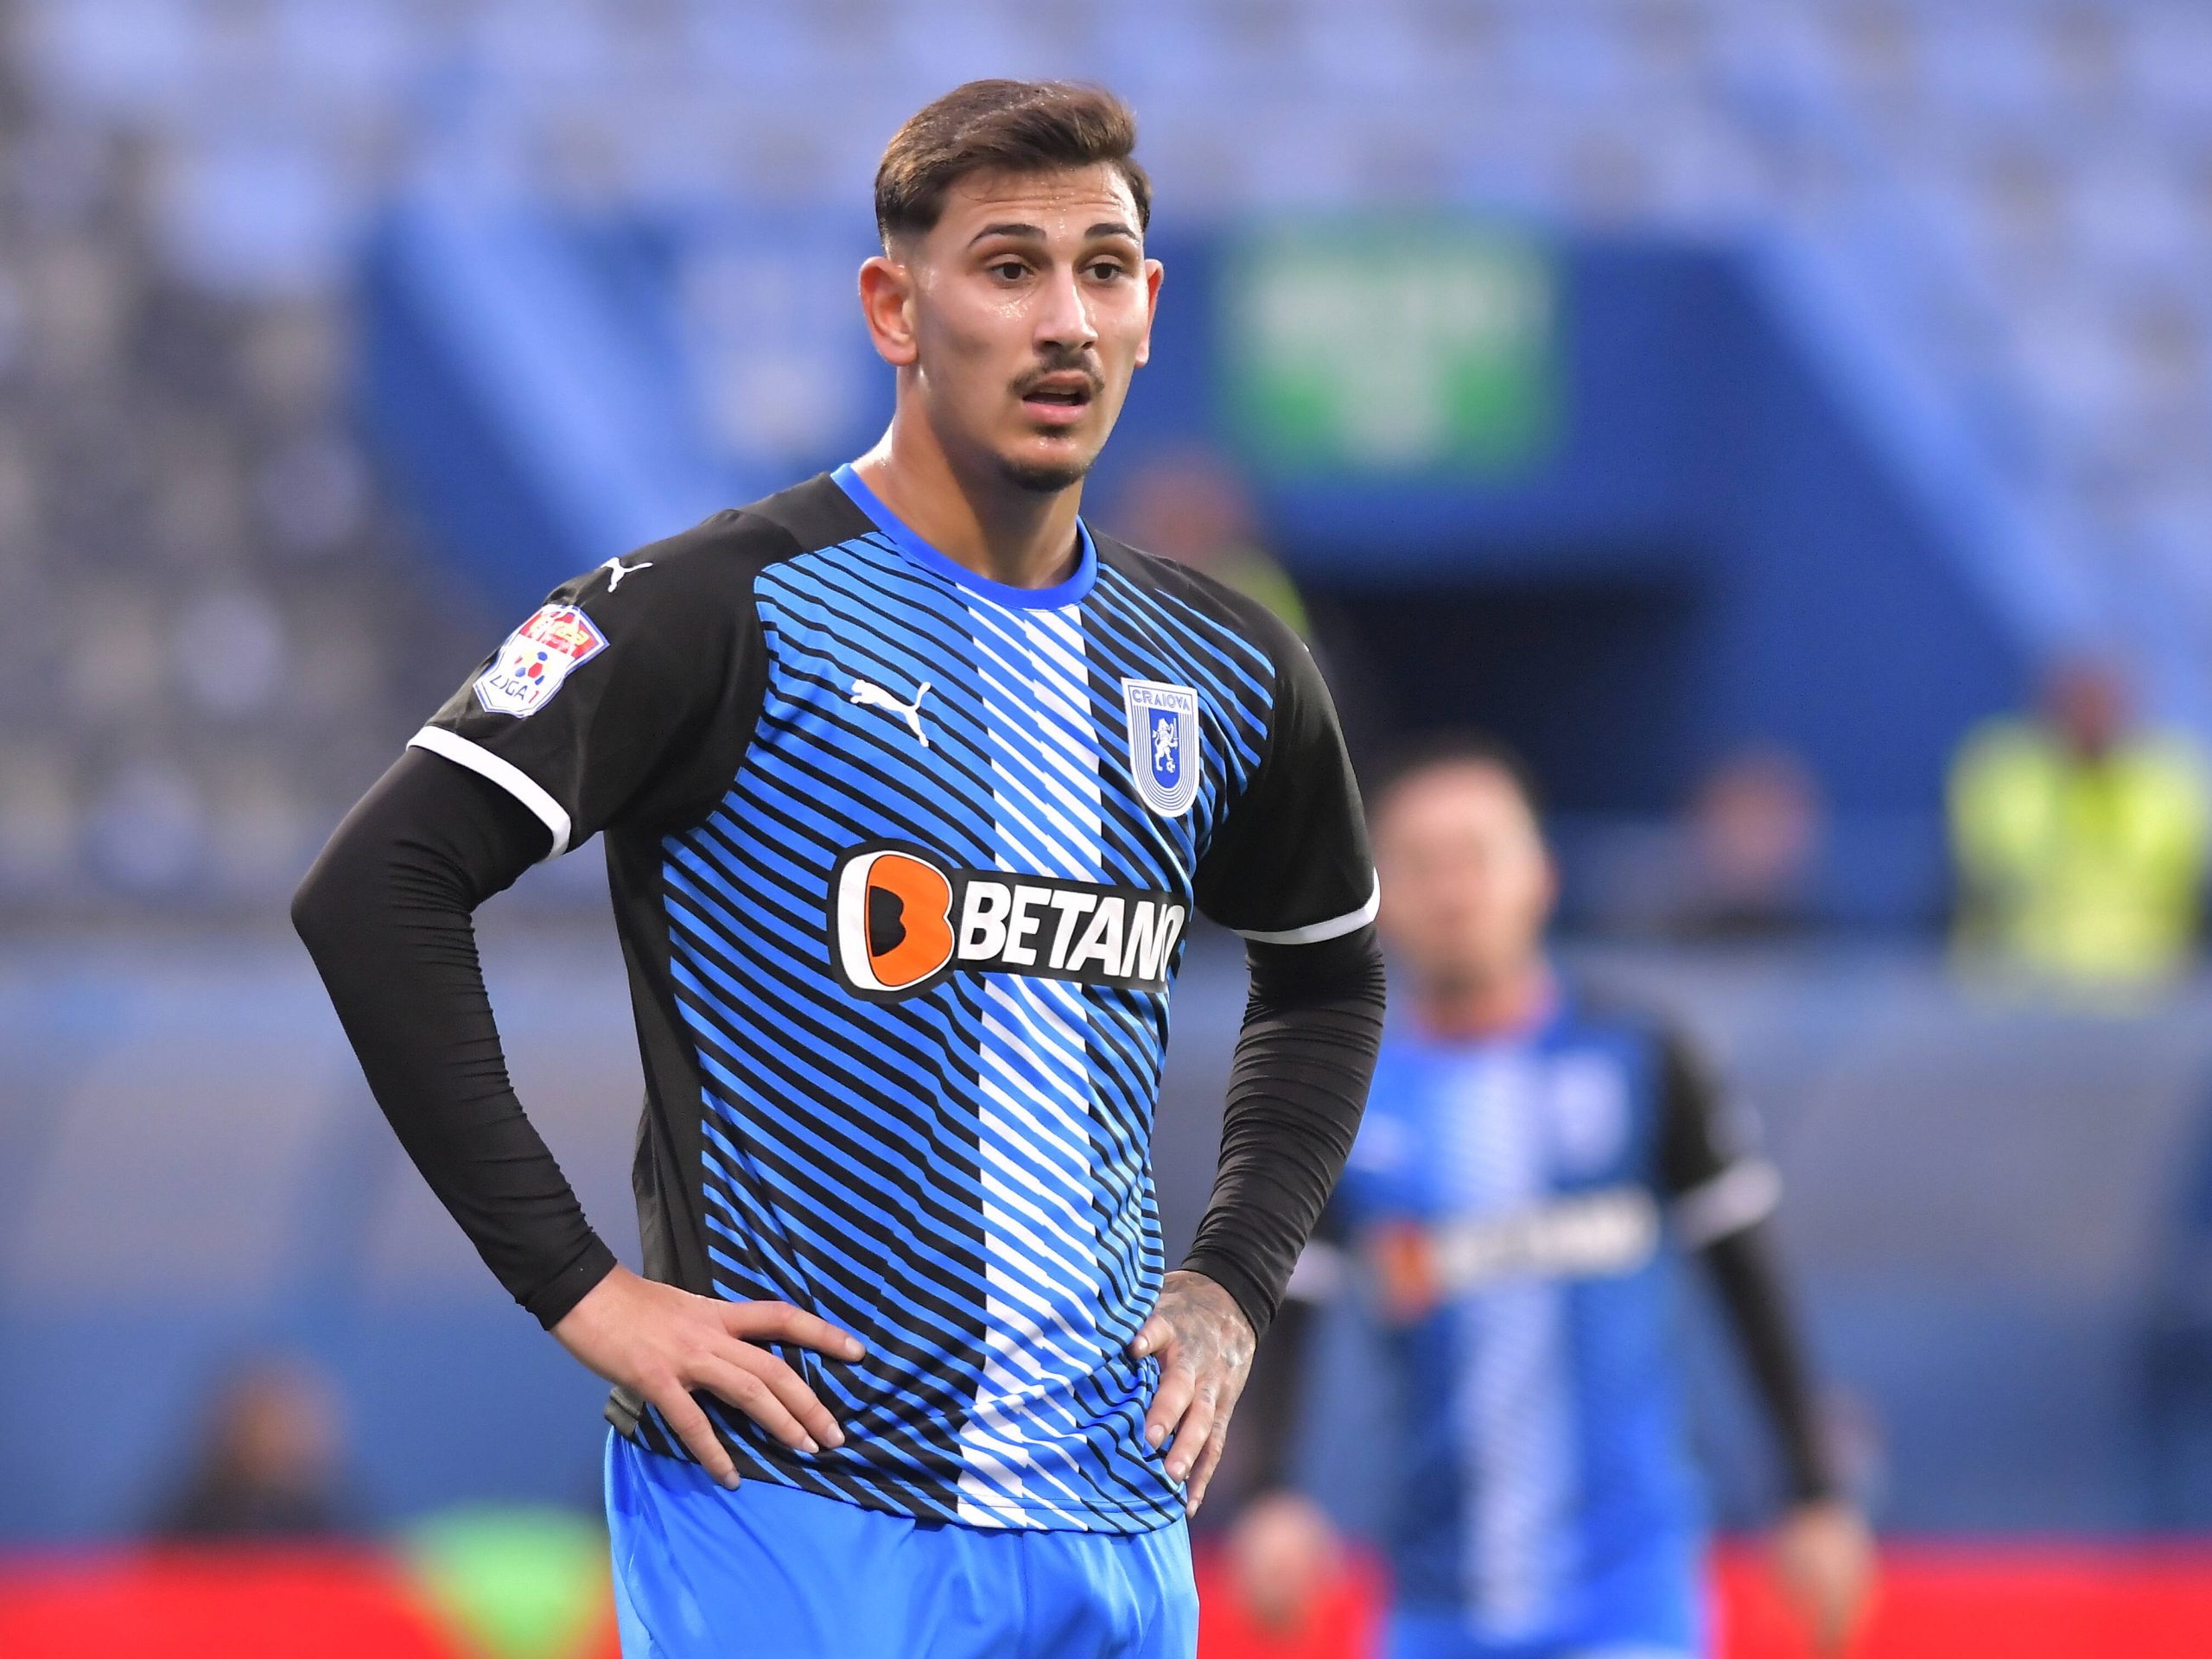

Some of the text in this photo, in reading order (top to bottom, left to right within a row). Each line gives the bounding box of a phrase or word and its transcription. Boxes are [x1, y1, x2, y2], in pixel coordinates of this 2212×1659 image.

[490, 675, 540, 704] LIGA 1
[1132, 689, 1191, 712] CRAIOVA
